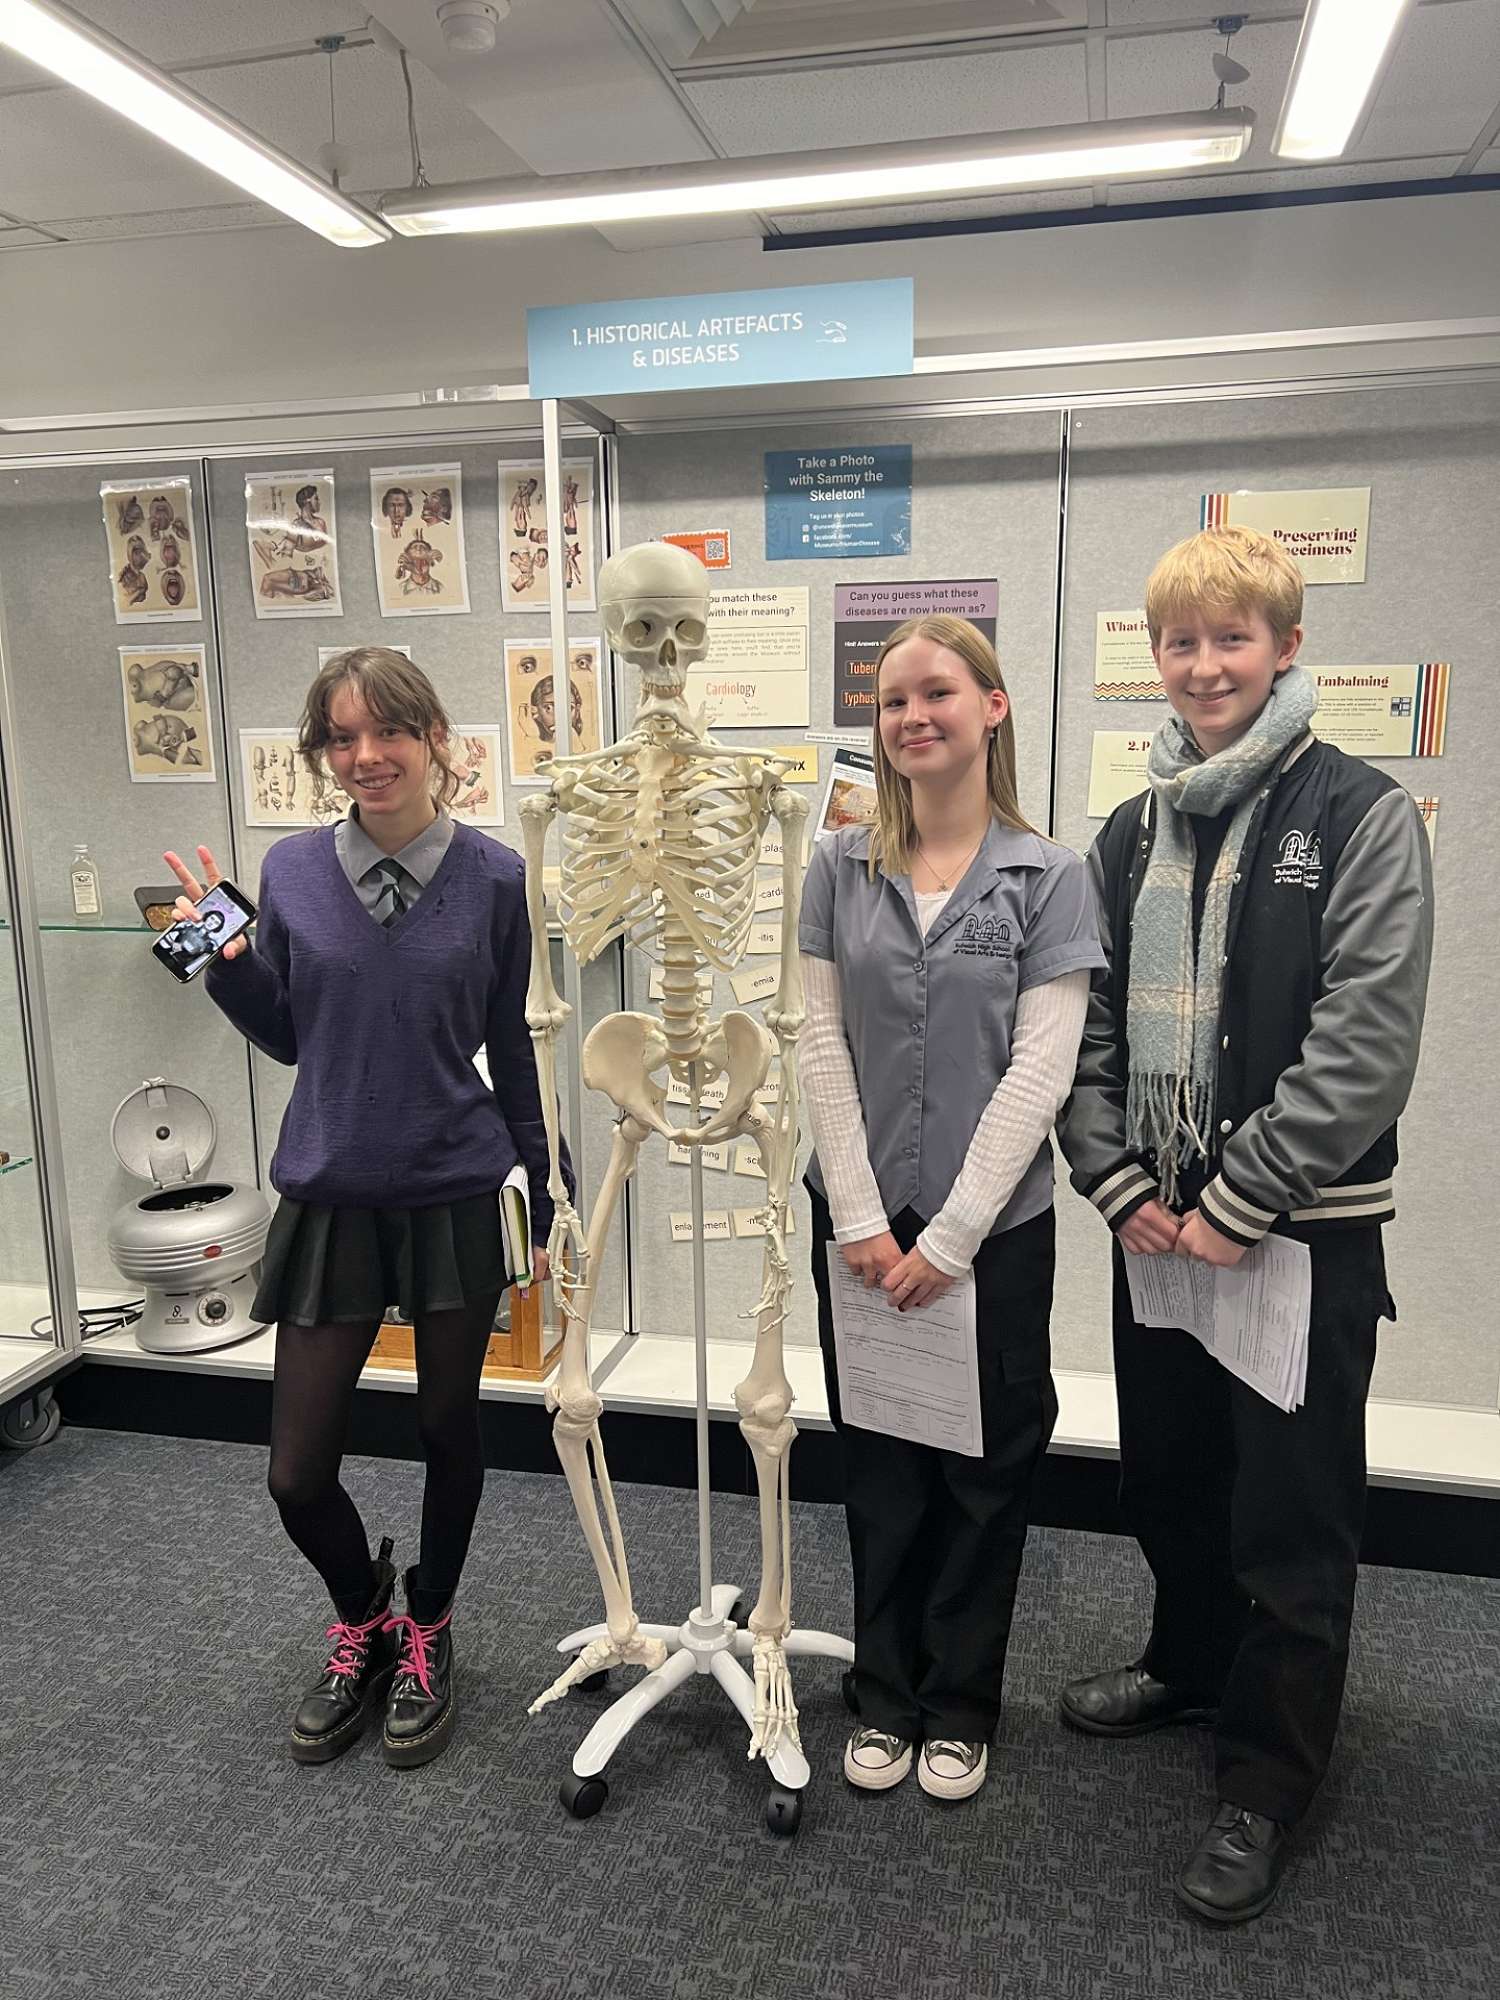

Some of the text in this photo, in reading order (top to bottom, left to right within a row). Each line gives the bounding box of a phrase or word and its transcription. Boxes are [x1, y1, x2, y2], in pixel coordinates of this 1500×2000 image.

[571, 311, 804, 346] 1. HISTORICAL ARTEFACTS
[632, 343, 741, 368] & DISEASES
[797, 454, 875, 469] Take a Photo
[789, 471, 884, 486] with Sammy the
[809, 487, 866, 502] Skeleton!
[1273, 527, 1358, 543] Preserving
[722, 593, 750, 602] match
[752, 592, 778, 602] these
[849, 587, 979, 602] Can you guess what these
[708, 606, 795, 617] with their meaning?
[845, 603, 986, 616] diseases are now known as?
[1105, 620, 1138, 632] What
[1317, 675, 1390, 688] Embalming
[705, 682, 756, 697] Cardiology
[844, 691, 875, 707] Typhus
[1127, 740, 1140, 751] 2.
[757, 931, 774, 943] -itis
